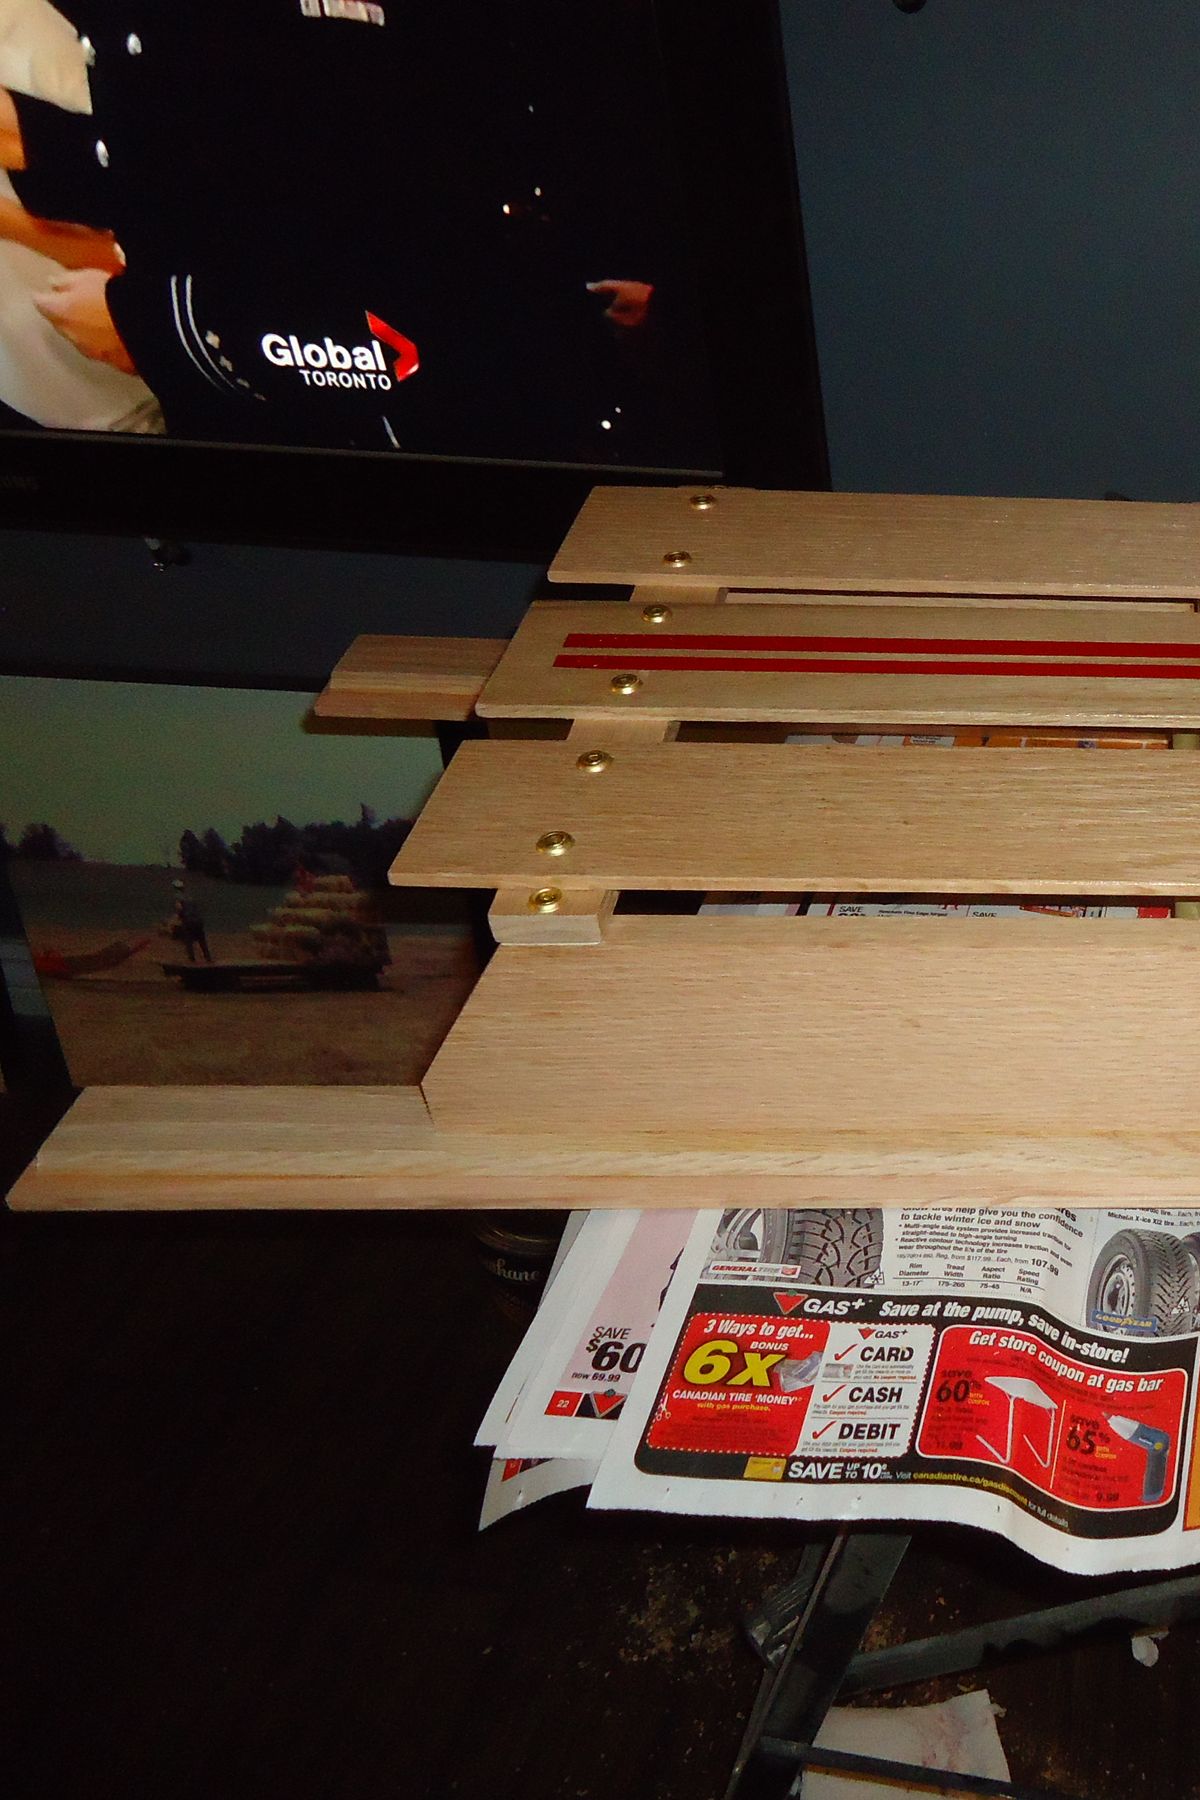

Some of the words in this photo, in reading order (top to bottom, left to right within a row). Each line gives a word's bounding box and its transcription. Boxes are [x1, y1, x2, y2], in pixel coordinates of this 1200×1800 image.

[261, 333, 388, 371] Global
[298, 369, 392, 390] TORONTO
[912, 1213, 942, 1221] tackle
[944, 1214, 974, 1223] winter
[977, 1216, 991, 1224] ice
[994, 1217, 1012, 1226] and
[1015, 1220, 1041, 1228] snow
[1107, 1211, 1133, 1221] Michelin
[978, 1208, 999, 1217] give
[1001, 1210, 1019, 1220] you
[1020, 1210, 1036, 1219] the
[1038, 1212, 1084, 1238] confidence
[981, 1227, 1009, 1235] provides
[1009, 1229, 1041, 1237] increased
[981, 1266, 1005, 1274] Aspect
[1030, 1257, 1060, 1276] 107.99
[943, 1270, 964, 1278] Width
[1018, 1268, 1040, 1278] Speed
[1016, 1276, 1039, 1286] Rating
[1019, 1286, 1032, 1294] N/A
[803, 1298, 866, 1316] GAS+
[592, 1326, 633, 1340] SAVE
[703, 1318, 717, 1334] 3
[718, 1319, 757, 1338] Ways
[759, 1321, 774, 1337] to
[776, 1324, 814, 1340] get...
[875, 1328, 908, 1340] GAS+
[880, 1301, 920, 1317] Save
[922, 1303, 942, 1317] at
[943, 1300, 971, 1317] the
[971, 1306, 1025, 1325] pump,
[1028, 1313, 1060, 1342] save
[1061, 1332, 1131, 1364] in-store!
[750, 1342, 790, 1351] BONUS
[586, 1337, 647, 1374] $60
[860, 1346, 914, 1361] CARD
[969, 1331, 997, 1347] Get
[998, 1335, 1038, 1355] store
[1038, 1348, 1085, 1385] coupon
[1087, 1374, 1104, 1388] at
[1104, 1377, 1134, 1393] gas
[1136, 1378, 1164, 1393] bar
[592, 1373, 622, 1383] 69.99
[673, 1390, 726, 1401] CANADIAN
[729, 1392, 752, 1402] TIRE
[848, 1386, 903, 1402] CASH
[557, 1400, 571, 1409] 22
[716, 1403, 731, 1411] gas
[732, 1404, 772, 1412] purchase.
[838, 1423, 901, 1440] DEBIT
[788, 1462, 844, 1479] SAVE
[846, 1463, 860, 1471] UP
[845, 1471, 858, 1479] TO
[895, 1472, 912, 1480] Visit
